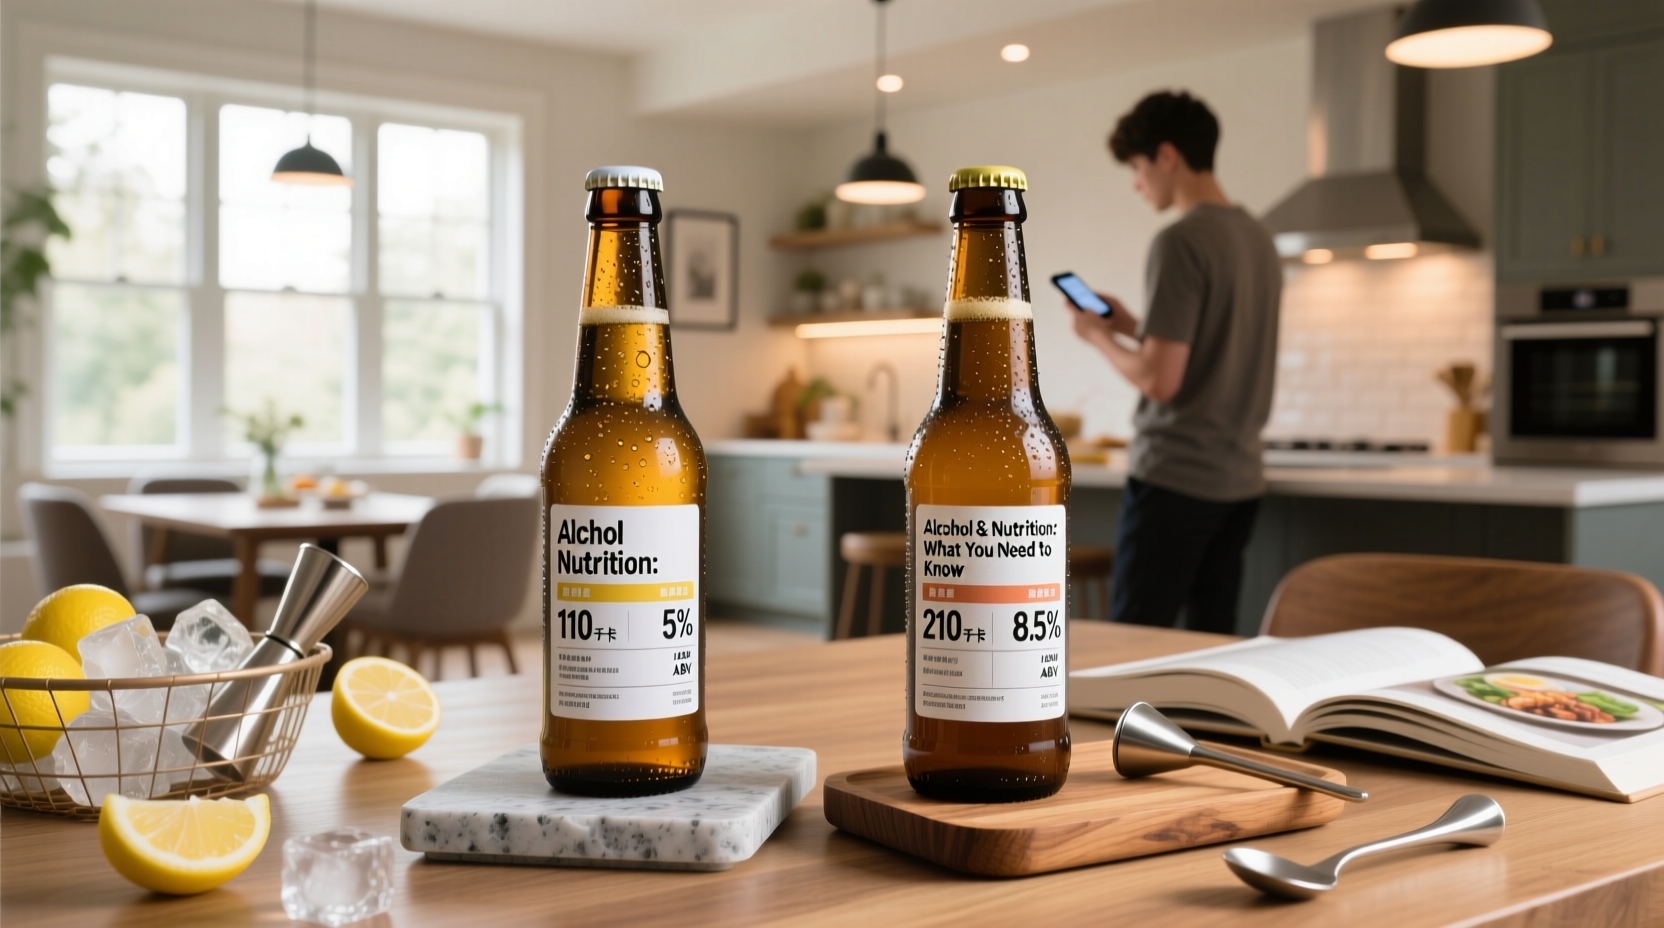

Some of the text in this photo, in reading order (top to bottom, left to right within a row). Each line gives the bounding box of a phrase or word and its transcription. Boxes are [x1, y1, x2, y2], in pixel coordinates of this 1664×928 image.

[557, 519, 624, 546] Alchol
[923, 518, 1058, 537] Alcohol & Nutrition:
[923, 539, 1053, 558] What You Need to
[557, 549, 659, 576] Nutrition:
[923, 560, 965, 578] Know
[662, 607, 694, 640] 5%
[1012, 609, 1062, 642] 8.5%
